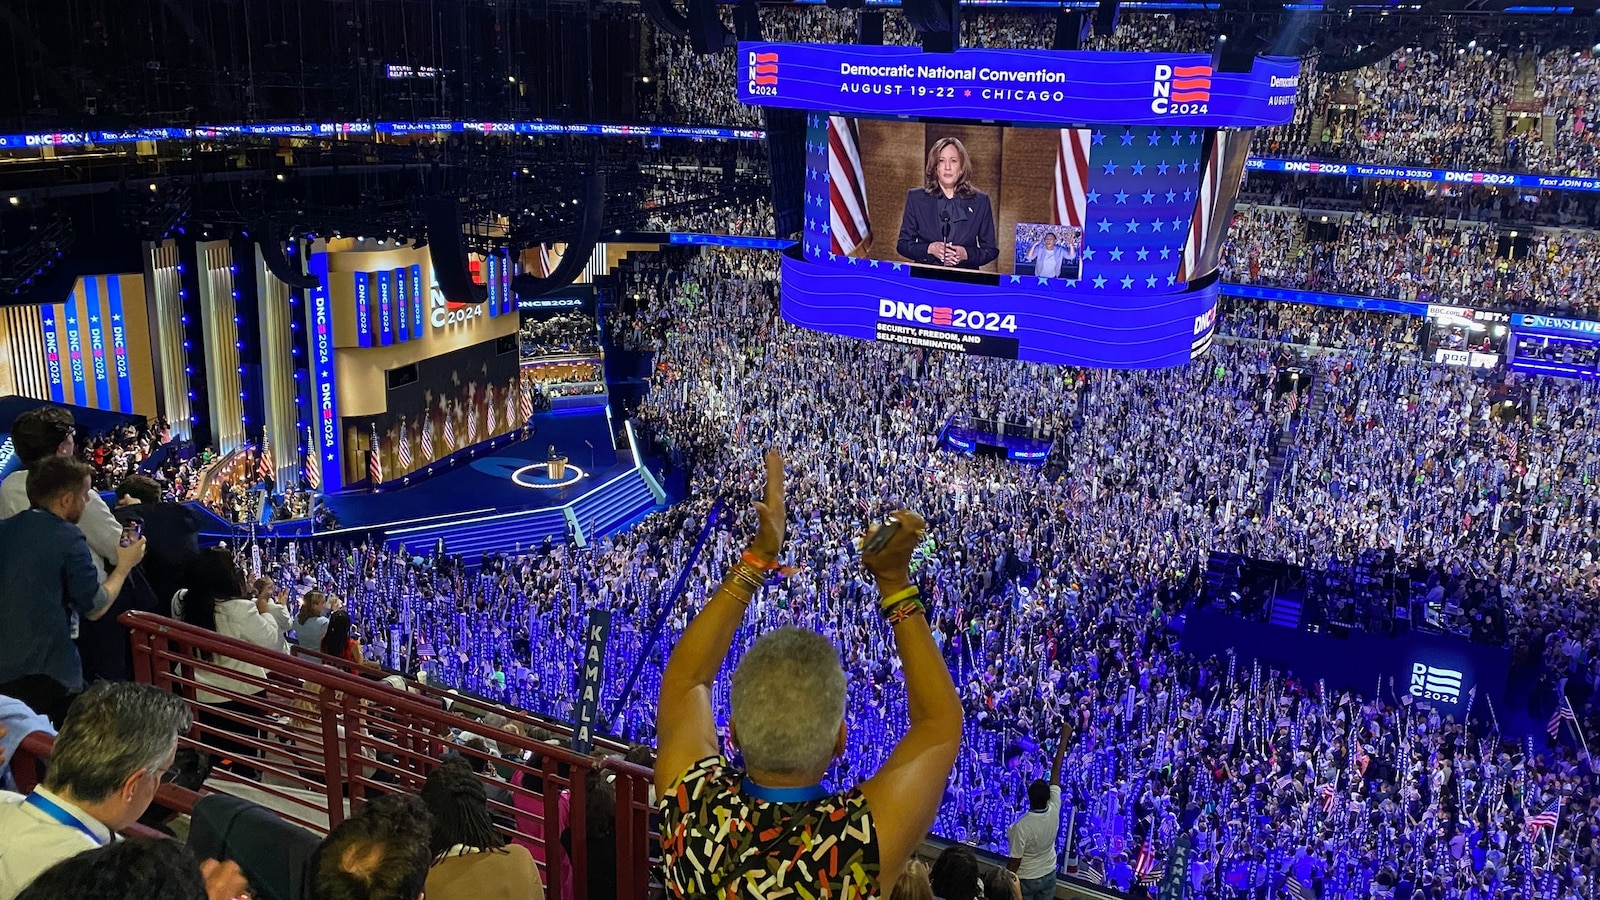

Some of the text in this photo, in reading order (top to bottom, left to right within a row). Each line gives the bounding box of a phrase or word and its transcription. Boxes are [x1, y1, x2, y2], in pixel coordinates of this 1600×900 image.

[841, 63, 1067, 83] Democratic National Convention
[755, 85, 778, 96] 2024
[840, 82, 1065, 102] AUGUST 19-22 CHICAGO
[1169, 103, 1209, 114] 2024
[1284, 161, 1310, 172] DNC
[1318, 162, 1347, 174] 2024
[1356, 167, 1374, 175] Text
[1375, 168, 1394, 176] JOIN
[1406, 169, 1432, 178] 30330
[1445, 171, 1473, 182] DNC
[1482, 173, 1515, 184] 2024
[1538, 177, 1558, 186] Text
[1559, 178, 1582, 188] JOIN
[1583, 180, 1593, 189] to
[446, 303, 482, 324] 2024
[879, 298, 1018, 333] DNC 2024
[1430, 308, 1461, 317] BBC.com
[1474, 310, 1502, 322] BET
[876, 322, 982, 344] SECURITY, FREEDOM, AND
[1536, 316, 1572, 329] NEWS
[1571, 320, 1600, 333] LIVE
[318, 334, 329, 364] 2024
[876, 331, 967, 352] SELF-DETERMINATION.
[49, 360, 60, 385] 2024
[72, 358, 83, 383] 2024
[94, 357, 105, 381] 2024
[116, 355, 127, 378] 2024
[323, 418, 334, 448] 2024
[578, 625, 603, 743] KAMALA
[1424, 690, 1459, 705] 2024
